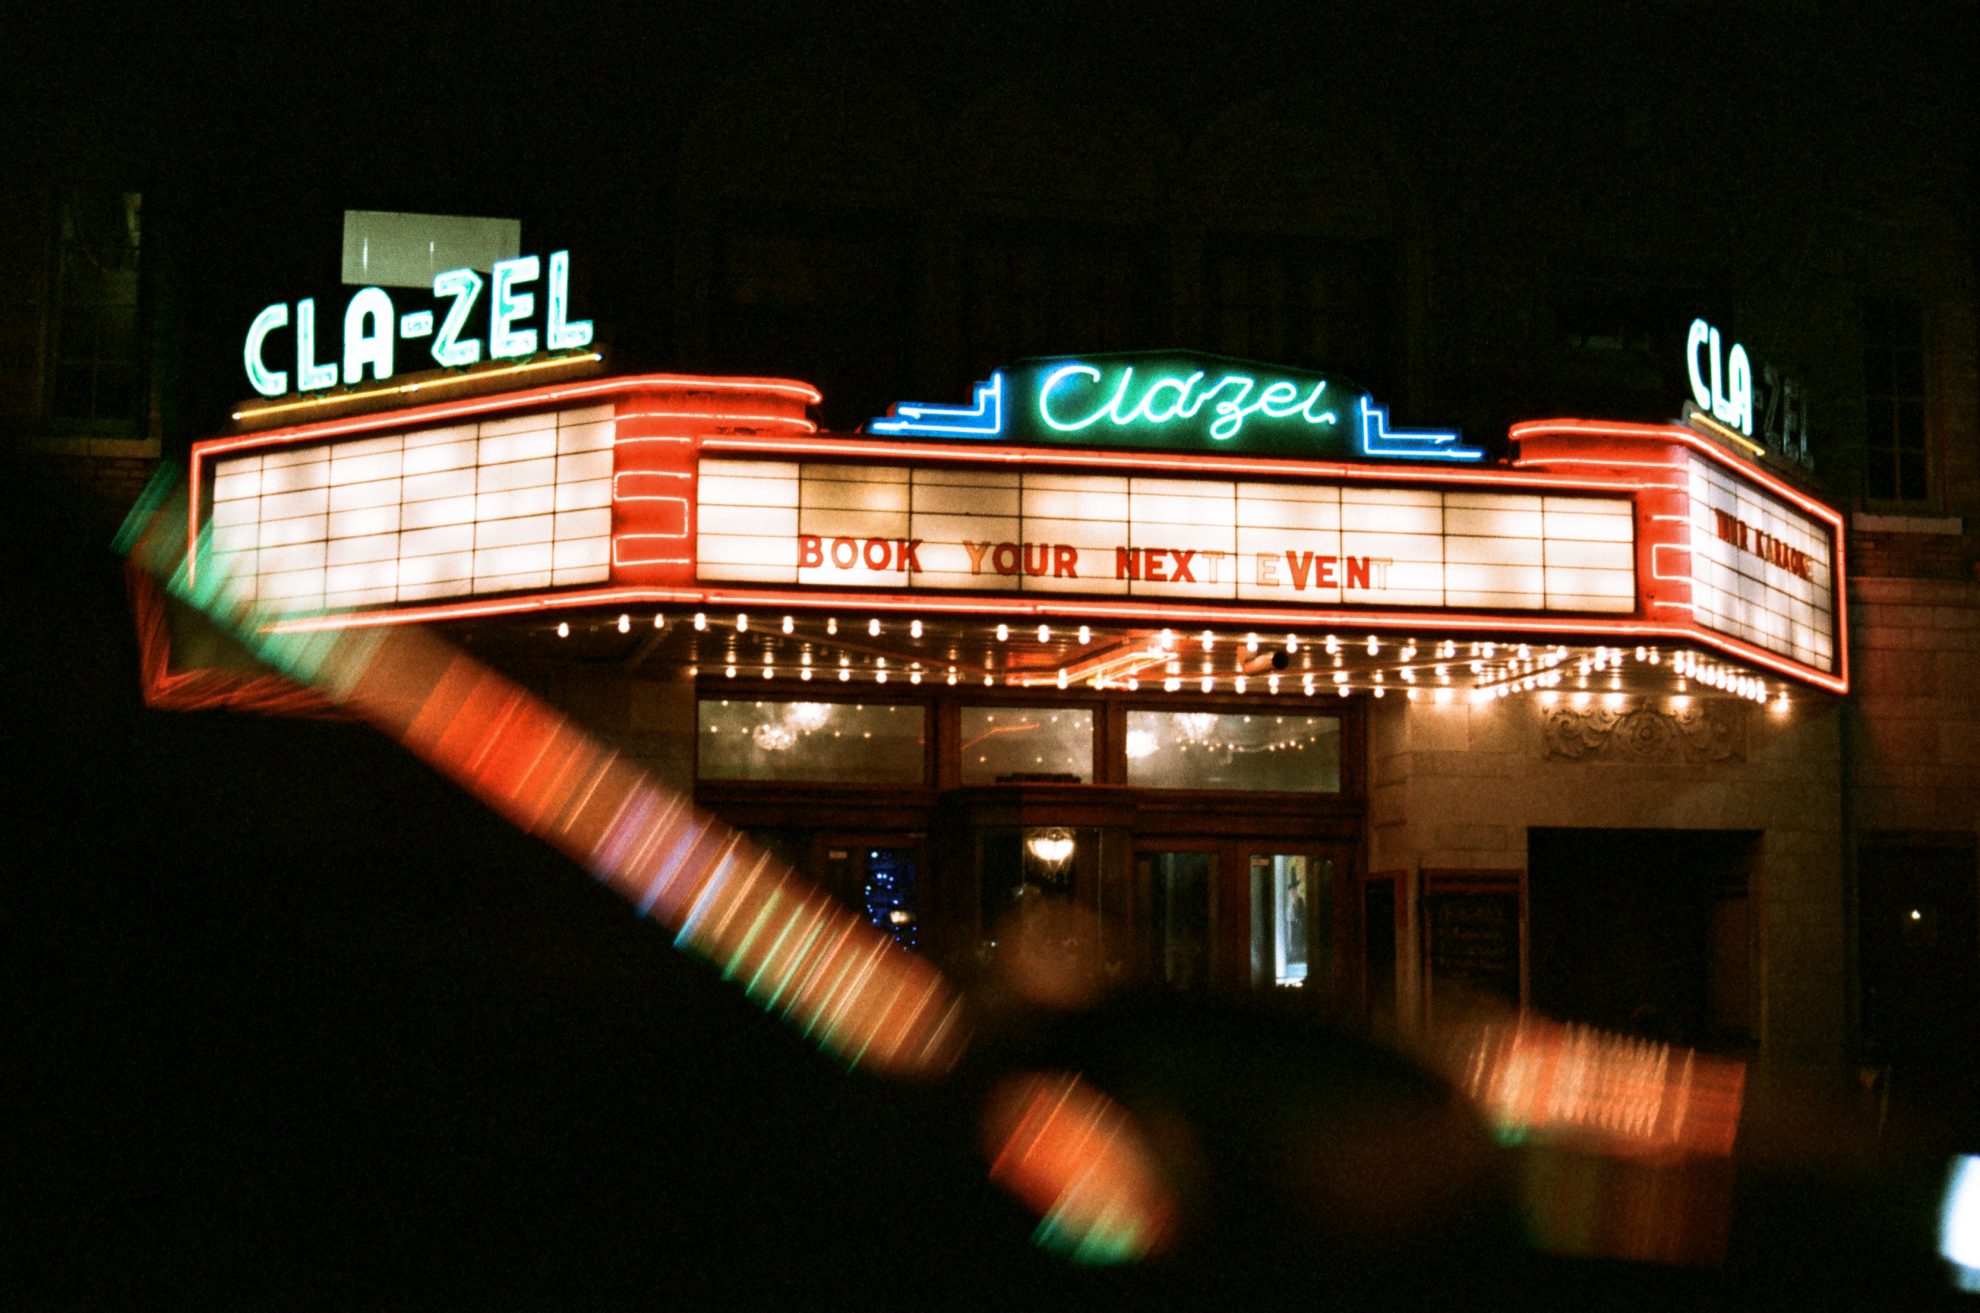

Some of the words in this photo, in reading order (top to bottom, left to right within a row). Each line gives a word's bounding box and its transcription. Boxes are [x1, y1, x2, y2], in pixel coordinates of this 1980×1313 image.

[244, 249, 593, 396] CLA-ZEL
[1039, 365, 1337, 440] Clazel
[799, 534, 923, 573] BOOK
[963, 540, 1078, 579] YOUR
[1115, 546, 1225, 584] NEXT
[1256, 550, 1393, 591] EVENT
